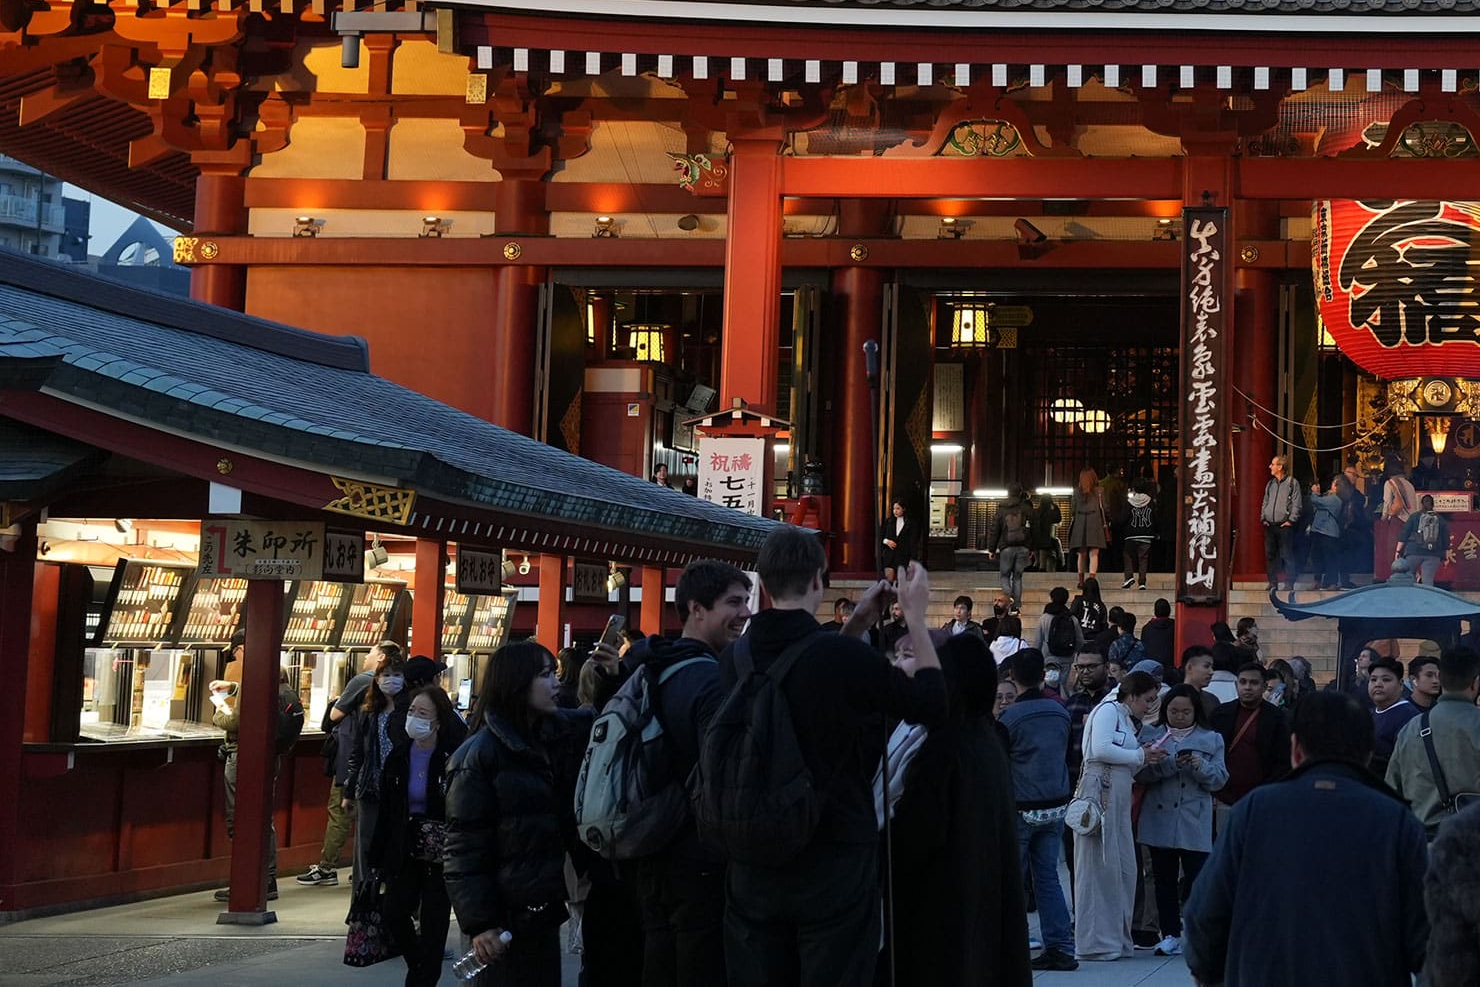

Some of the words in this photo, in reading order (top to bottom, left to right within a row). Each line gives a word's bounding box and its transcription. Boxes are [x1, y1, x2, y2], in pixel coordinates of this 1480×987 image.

[201, 536, 213, 574] この先左
[233, 529, 318, 559] 朱印所
